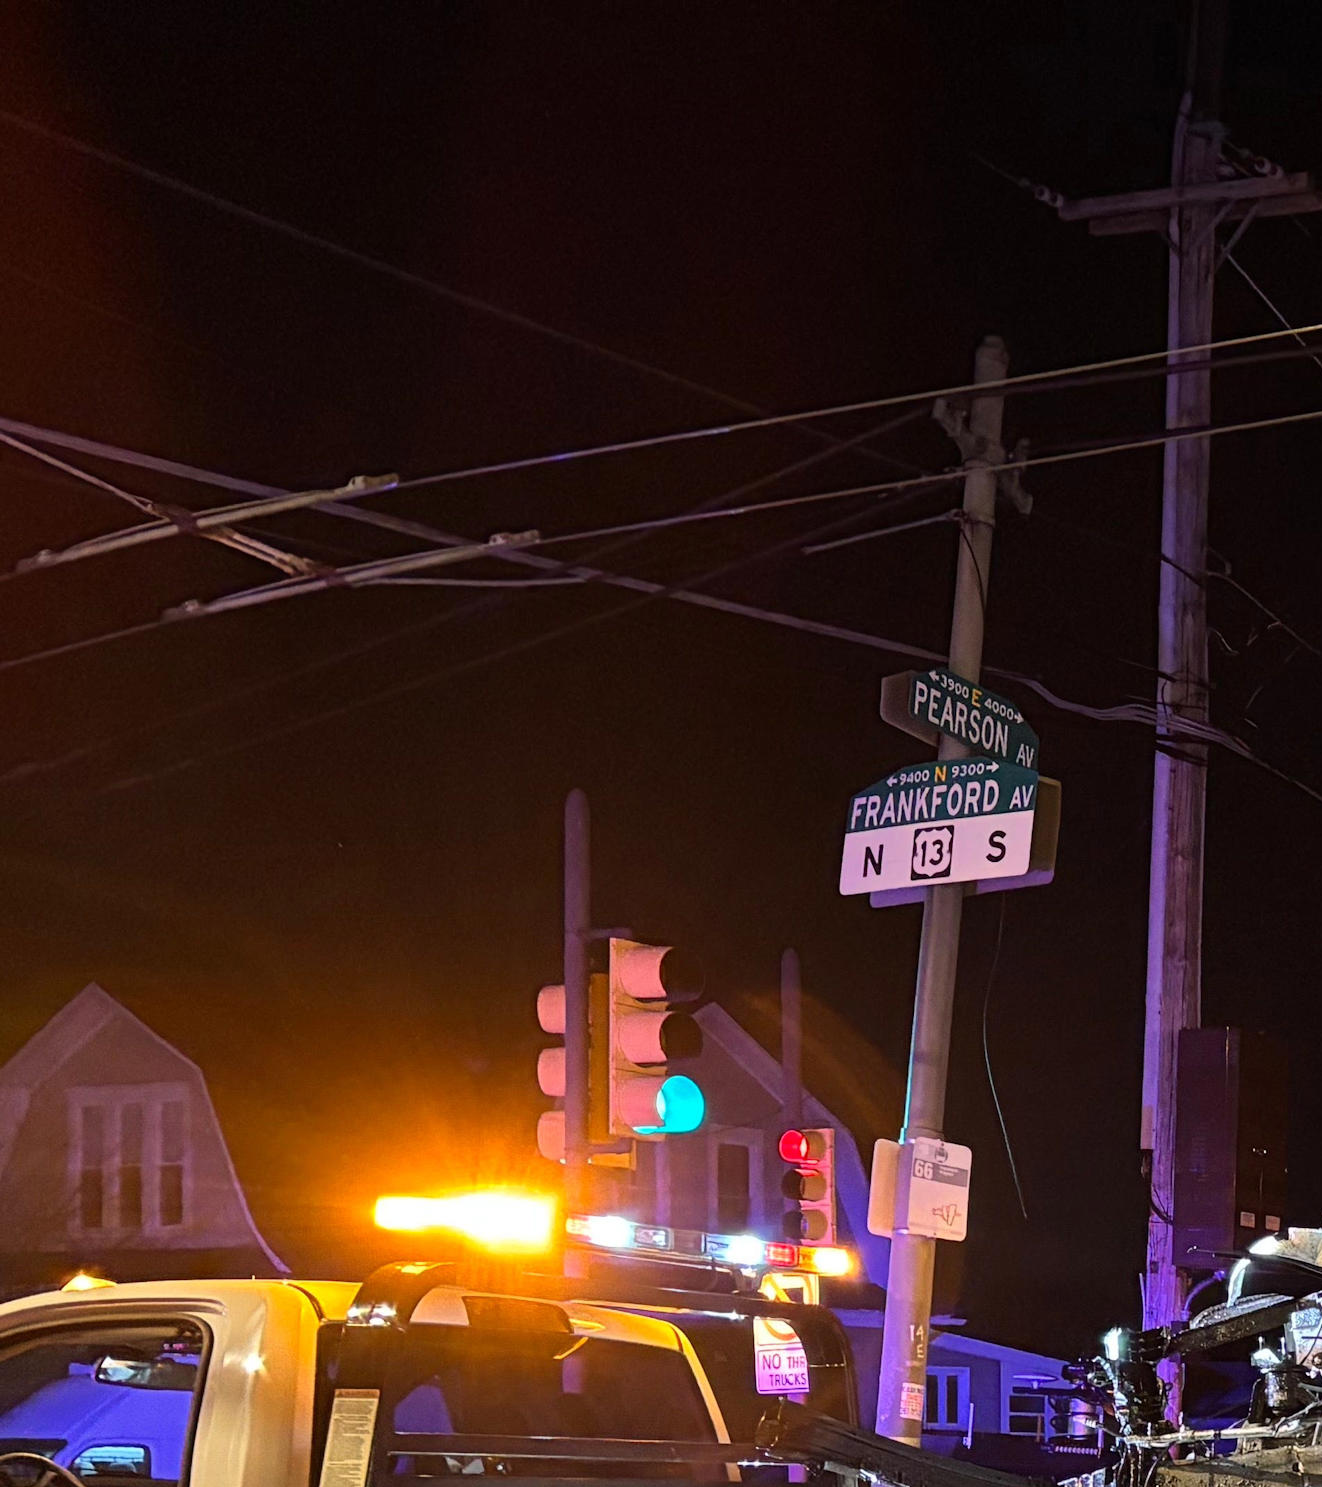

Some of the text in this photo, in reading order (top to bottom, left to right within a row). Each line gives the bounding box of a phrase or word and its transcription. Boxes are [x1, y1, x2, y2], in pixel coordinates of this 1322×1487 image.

[939, 674, 1014, 721] 3900 E 4000
[913, 681, 1035, 768] PEARSON AV
[899, 763, 985, 785] 9400 N 9300
[850, 779, 1035, 830] FRANKFORD AV
[862, 830, 1007, 877] N 13 S
[914, 1160, 934, 1180] 66
[761, 1353, 806, 1371] NO THR
[769, 1372, 807, 1388] TRUCKS
